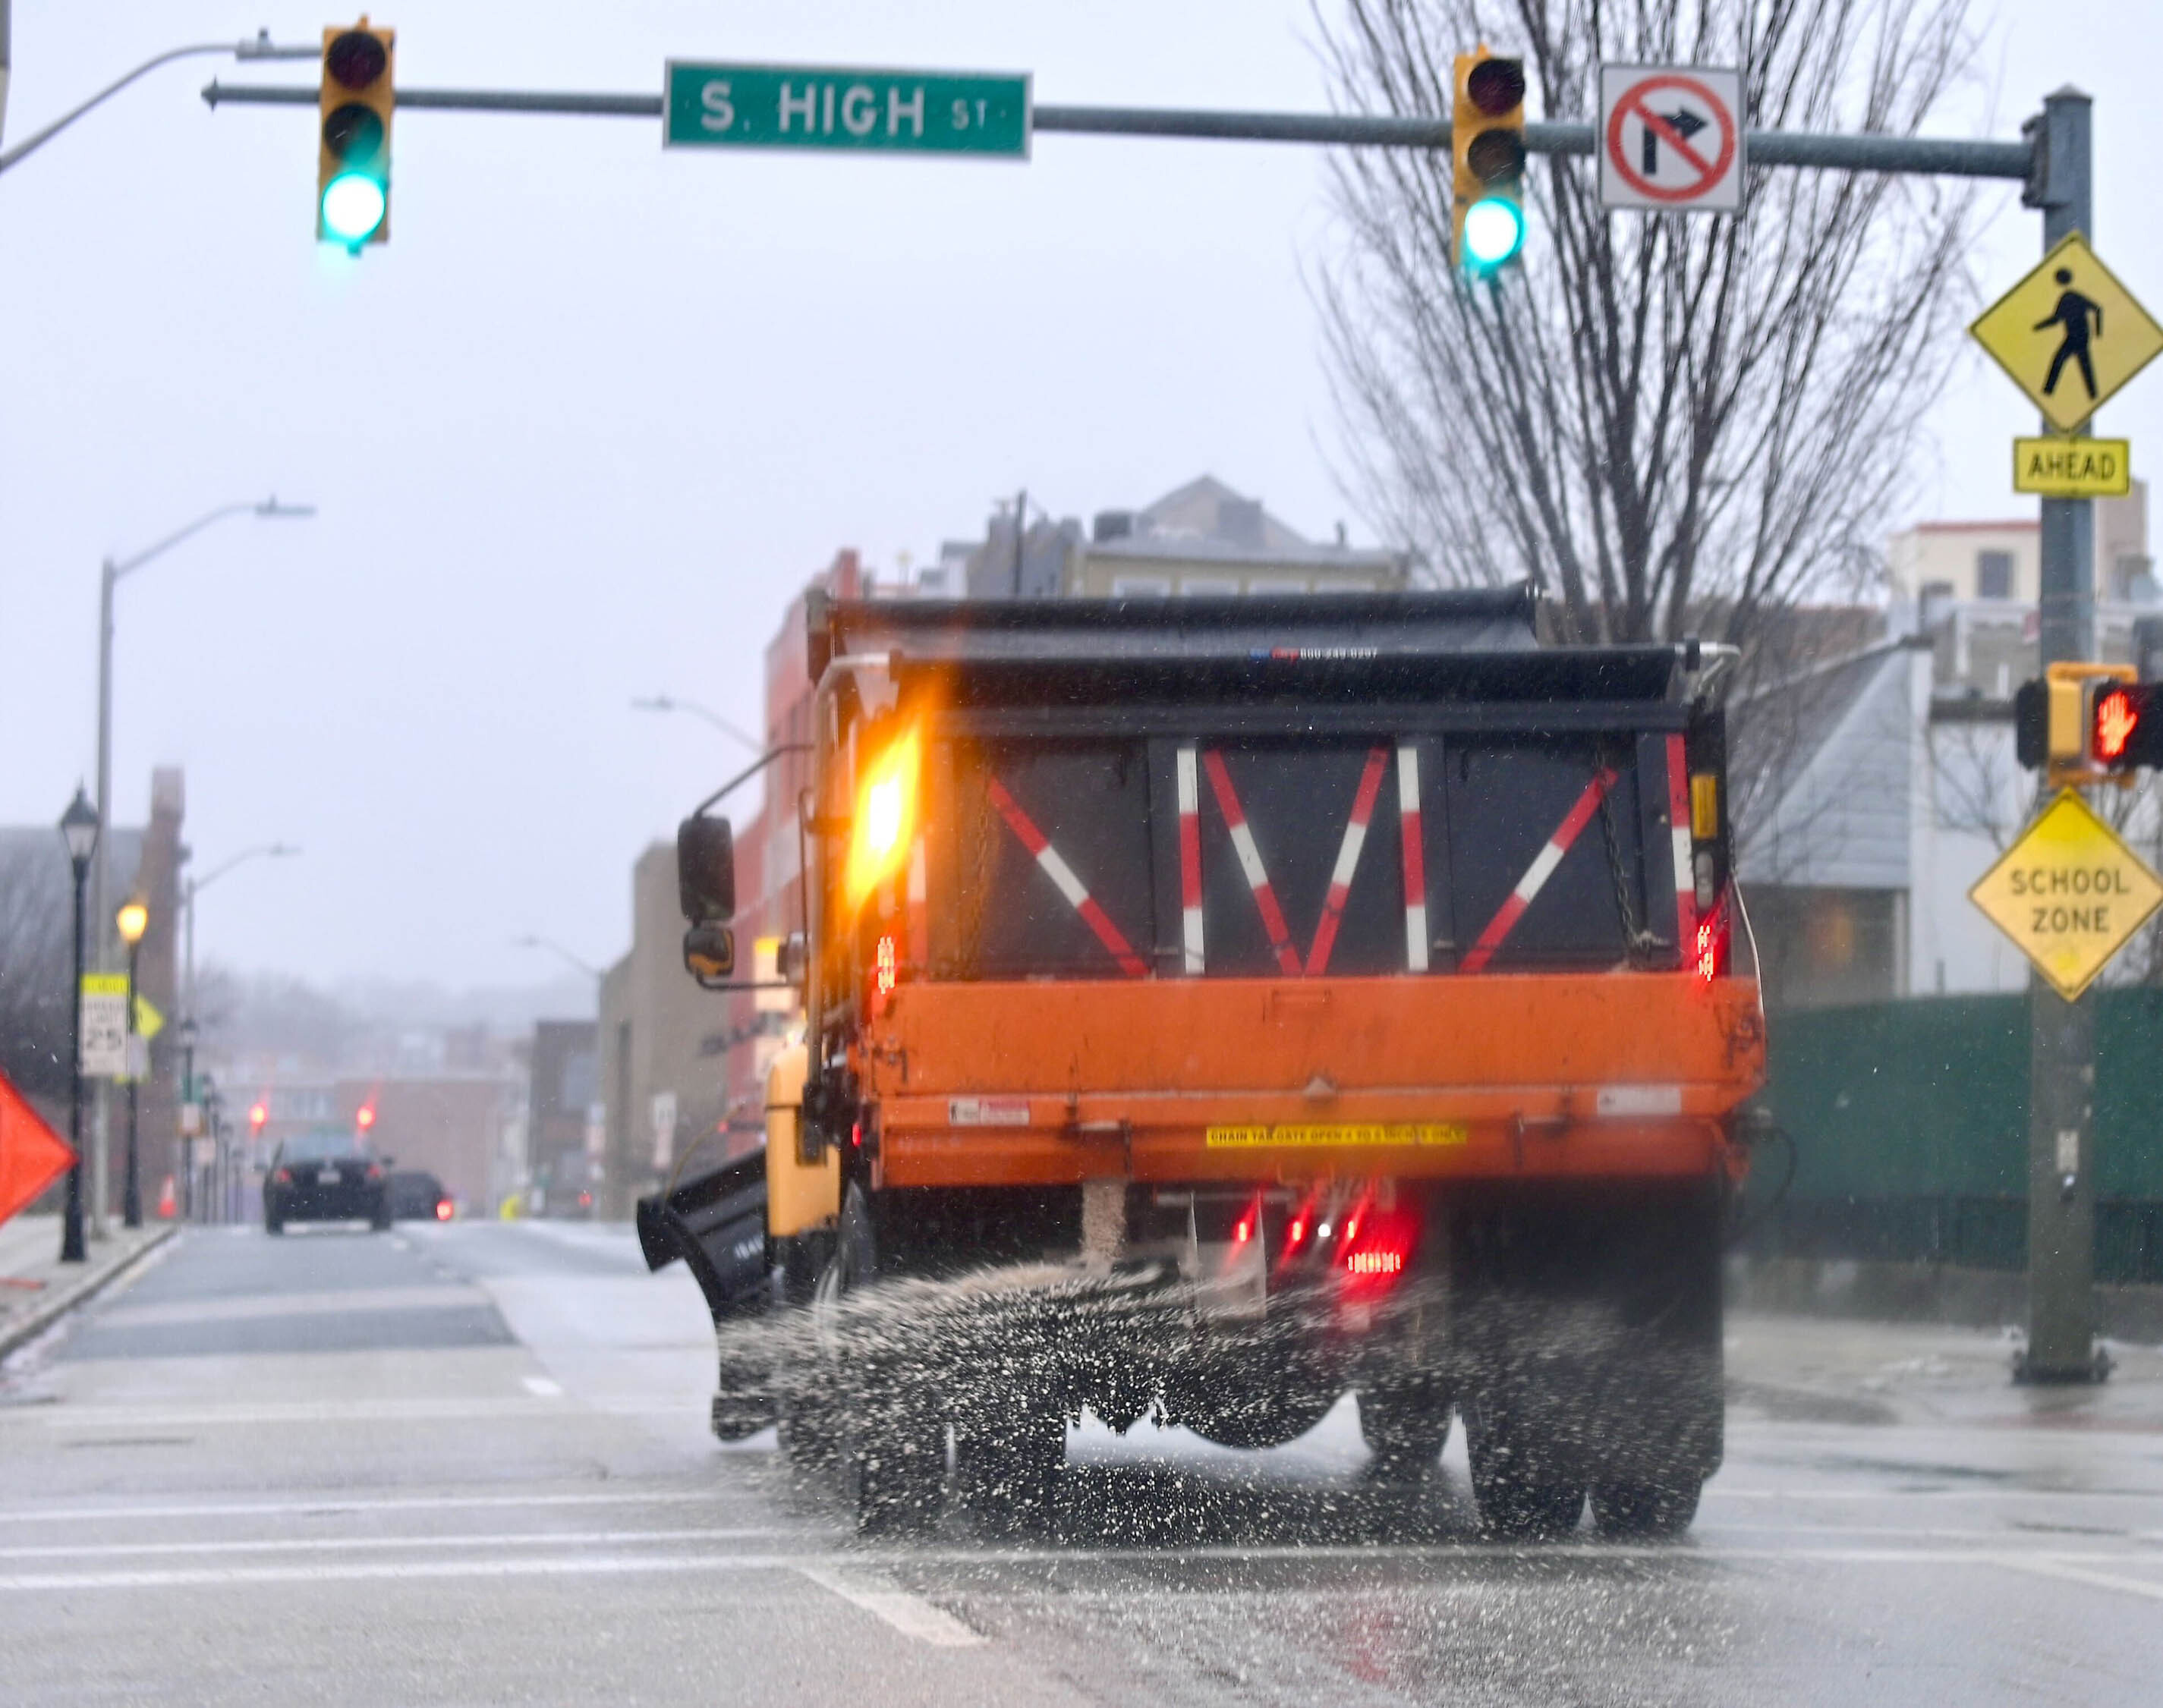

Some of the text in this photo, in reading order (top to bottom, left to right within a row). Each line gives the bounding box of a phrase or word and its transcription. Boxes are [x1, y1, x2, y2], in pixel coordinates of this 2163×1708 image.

[778, 82, 925, 138] HIGH
[2027, 452, 2116, 481] AHEAD
[2010, 868, 2131, 896] SCHOOL
[2032, 907, 2111, 934] ZONE
[1211, 1130, 1248, 1142] CHAIN
